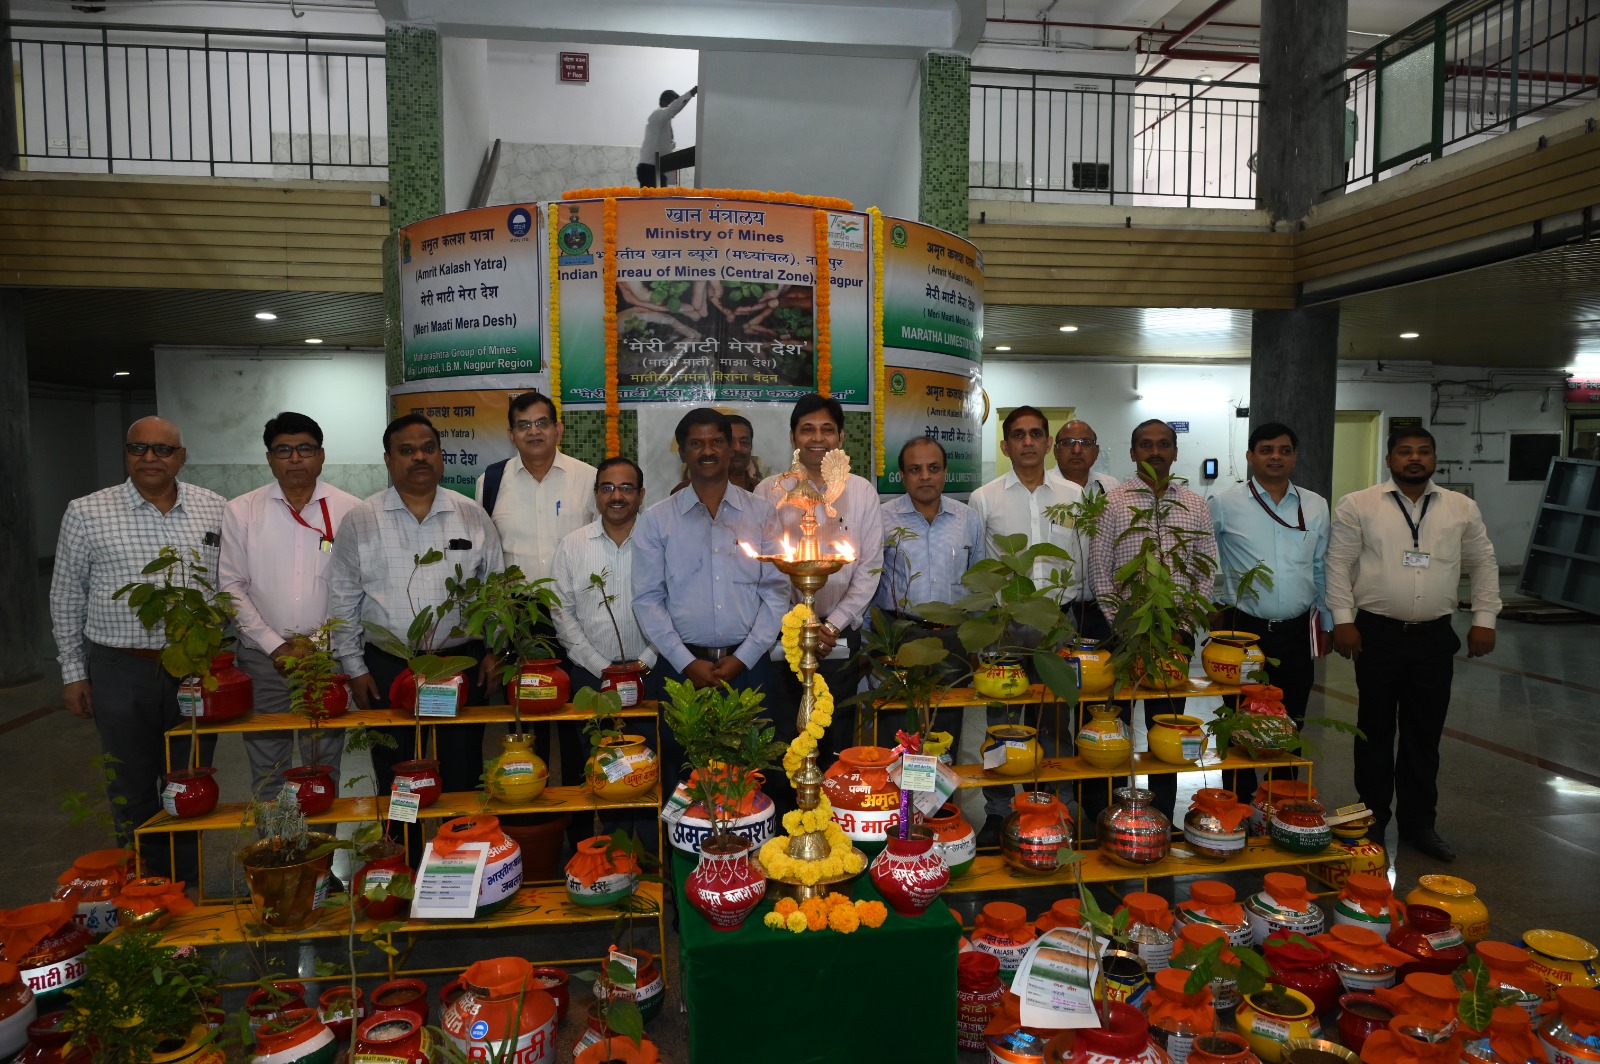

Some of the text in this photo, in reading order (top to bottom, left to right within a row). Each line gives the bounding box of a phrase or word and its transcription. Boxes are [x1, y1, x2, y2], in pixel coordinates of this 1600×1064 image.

[666, 204, 766, 226] खान मंत्रालय
[420, 228, 494, 256] अमृत कलश यात्रा
[646, 228, 784, 242] Ministry of Mines
[596, 248, 646, 260] भरतीय
[651, 249, 682, 260] खान
[688, 246, 720, 262] ब्यूरो
[806, 256, 844, 271] नापुर
[927, 242, 944, 260] अमृत
[416, 256, 507, 282] (Amrit Kalash Yatra)
[558, 266, 863, 288] Indian ureau of Mines (Central Zone), agpur
[932, 266, 946, 278] Amrit
[420, 283, 498, 306] मेरी माटी मेरा देश
[926, 283, 940, 300] मेरी
[942, 290, 956, 304] माटी
[928, 308, 940, 318] Meri
[413, 313, 516, 338] (Meri Maati Mera Desh)
[902, 326, 942, 344] MARATHA
[414, 346, 516, 362] Maharashtra Group of Mines
[674, 337, 720, 353] माटी
[728, 338, 763, 354] मेरा
[464, 360, 495, 372] Nagpur
[498, 358, 532, 370] Region
[720, 358, 747, 366] माझा
[752, 357, 777, 369] देश)
[926, 386, 944, 401] अमृत
[427, 406, 450, 418] कलश
[453, 406, 475, 416] यात्रा
[930, 408, 946, 416] Amrit
[451, 429, 470, 438] Yatra
[925, 426, 938, 440] मेरी
[941, 428, 954, 442] माटी
[460, 449, 478, 466] देश
[456, 474, 476, 484] Desh
[861, 792, 900, 810] अमृत
[722, 886, 753, 903] कलश
[993, 948, 1014, 956] KALASH
[28, 962, 85, 991] माटी मेरा
[962, 1014, 991, 1022] Maati
